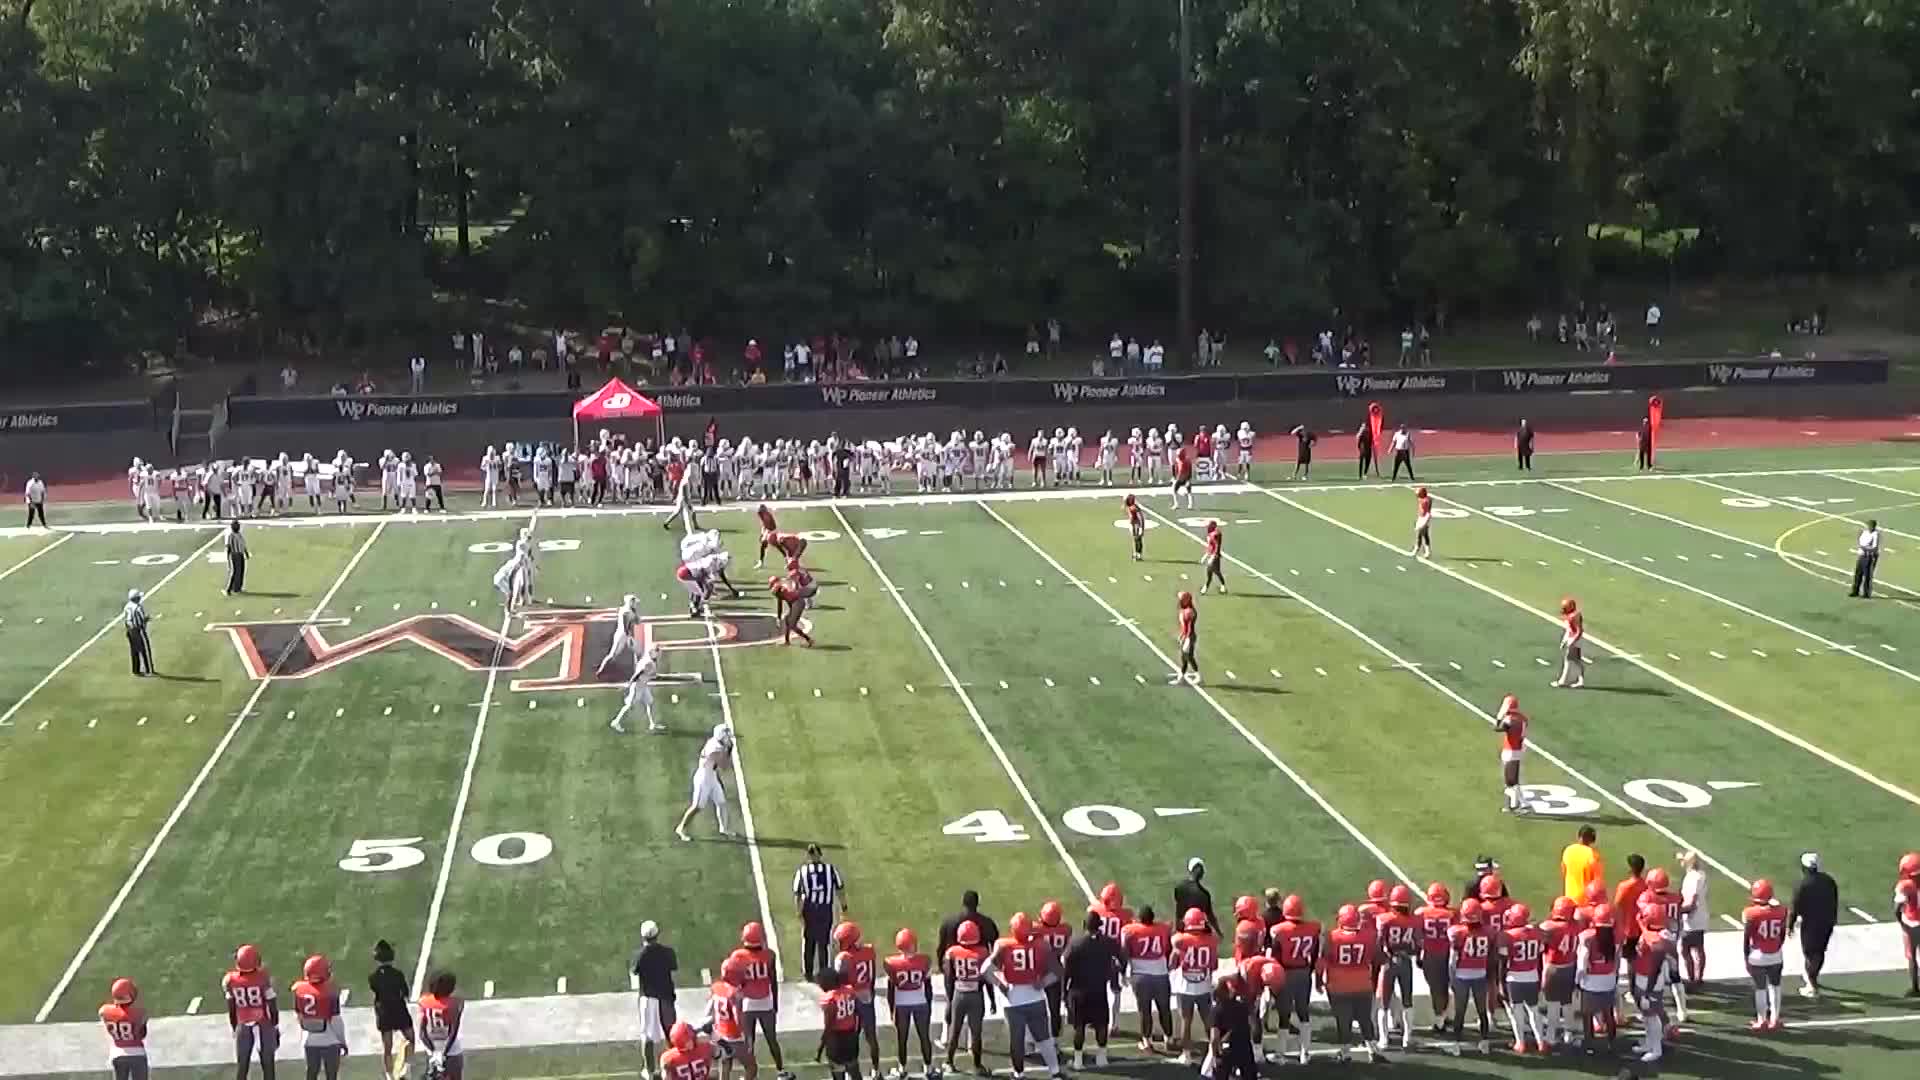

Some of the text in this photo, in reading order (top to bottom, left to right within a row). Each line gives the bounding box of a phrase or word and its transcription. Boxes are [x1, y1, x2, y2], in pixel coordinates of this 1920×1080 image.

[890, 388, 937, 401] Athletics
[367, 402, 408, 417] Pioneer
[410, 402, 457, 416] Athletics
[10, 413, 58, 428] Athletics
[1389, 926, 1413, 945] 84
[1757, 919, 1781, 939] 46
[1137, 937, 1162, 956] 74
[1290, 936, 1313, 959] 72
[1339, 944, 1364, 965] 67
[1464, 936, 1488, 957] 48
[1513, 940, 1538, 961] 30
[1012, 948, 1034, 971] 91
[1183, 947, 1211, 968] 40
[954, 957, 979, 980] 85
[231, 986, 262, 1008] 88
[303, 994, 316, 1015] 2
